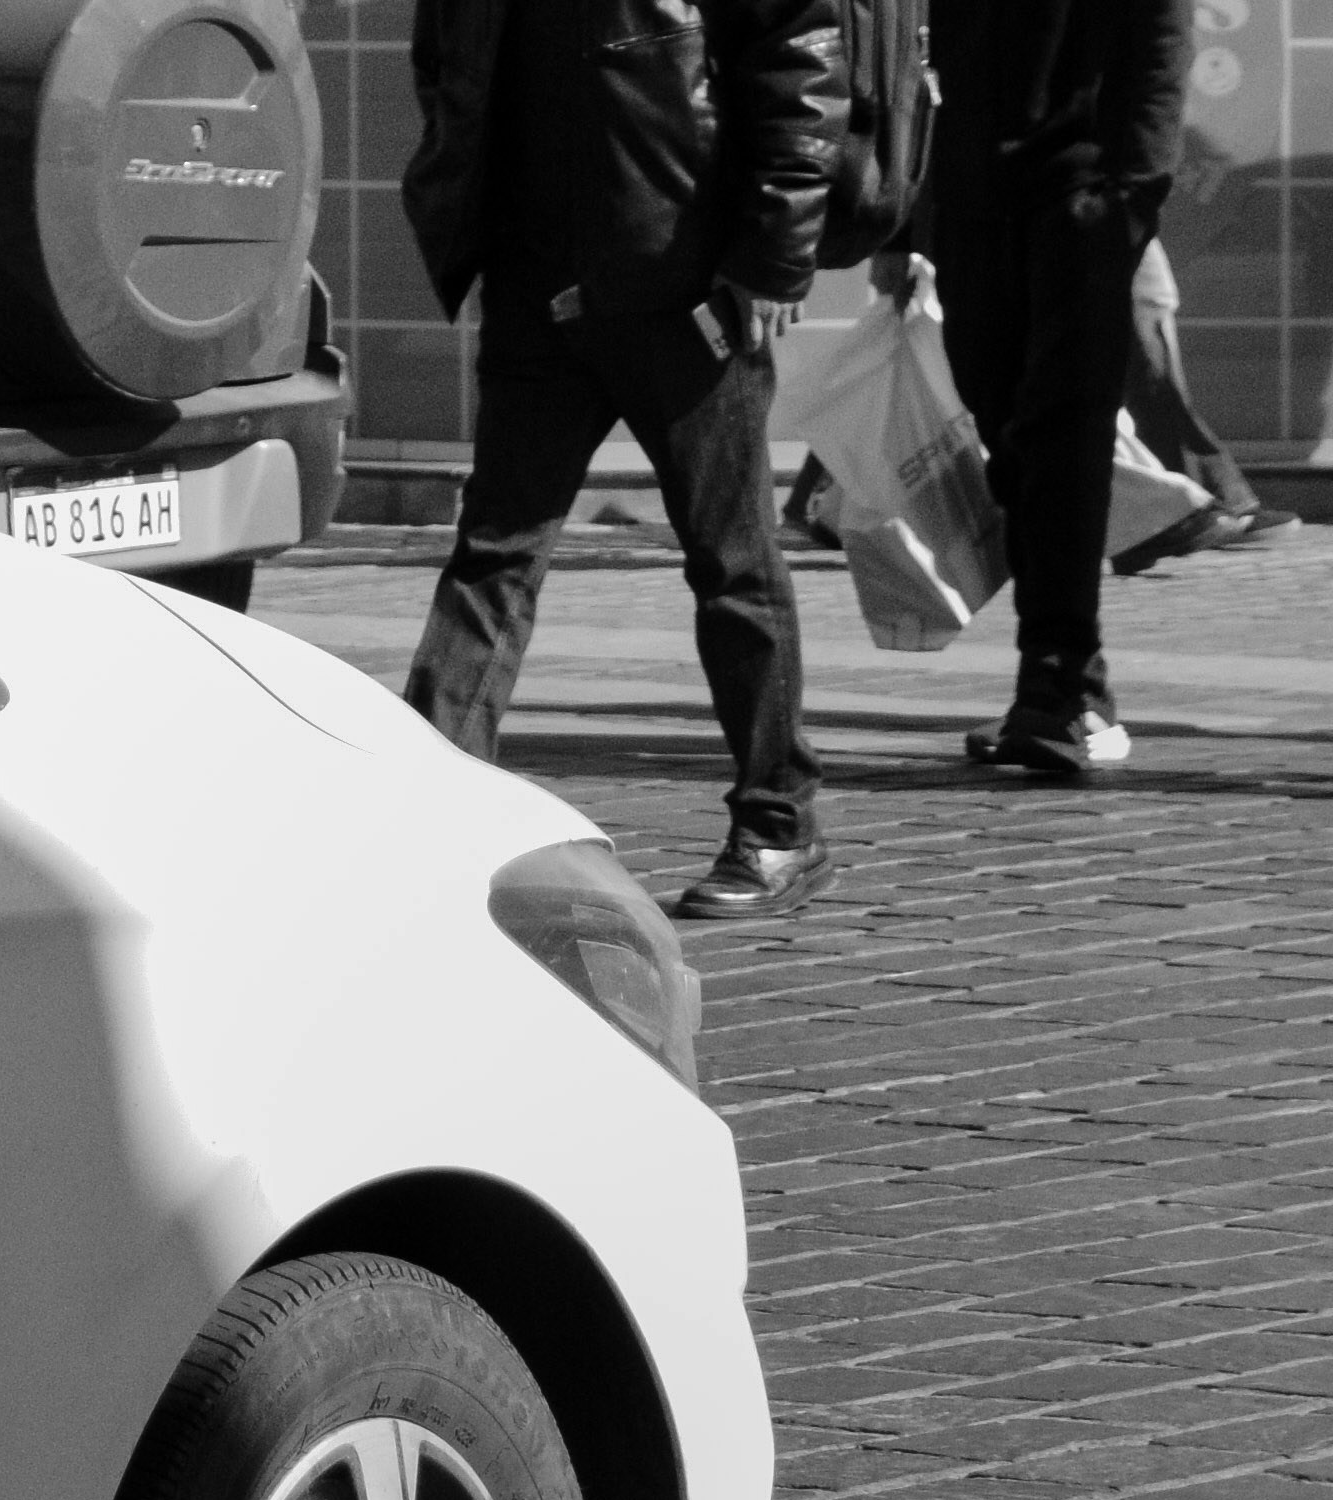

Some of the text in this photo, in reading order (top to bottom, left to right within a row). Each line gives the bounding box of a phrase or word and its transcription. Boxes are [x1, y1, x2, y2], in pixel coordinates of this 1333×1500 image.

[25, 489, 173, 548] AB 816 AH
